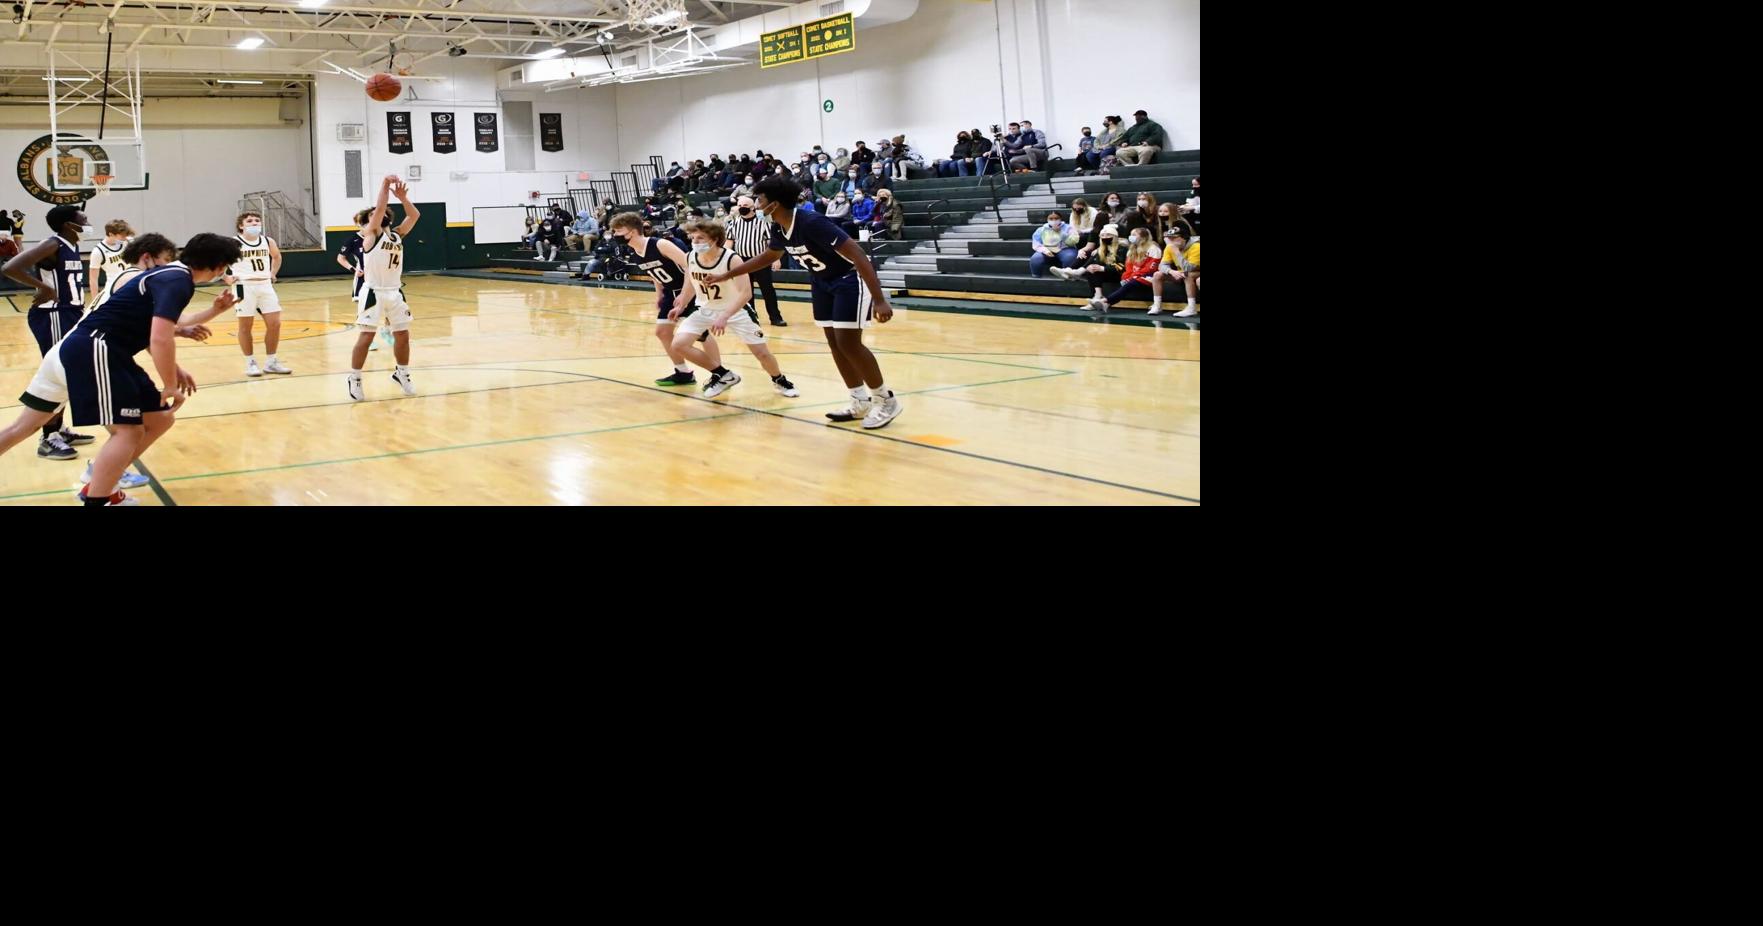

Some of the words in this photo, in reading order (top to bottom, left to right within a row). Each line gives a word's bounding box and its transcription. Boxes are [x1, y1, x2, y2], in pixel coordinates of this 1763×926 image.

[820, 16, 850, 30] BASKETBALL
[809, 44, 824, 54] STATE
[824, 38, 850, 50] CHAMPIONS
[764, 54, 777, 63] STATE
[777, 50, 800, 60] CHAMPIONS
[826, 102, 832, 111] 2
[250, 258, 264, 272] 10
[388, 253, 400, 269] 14
[646, 267, 673, 284] 10
[700, 284, 722, 300] 42
